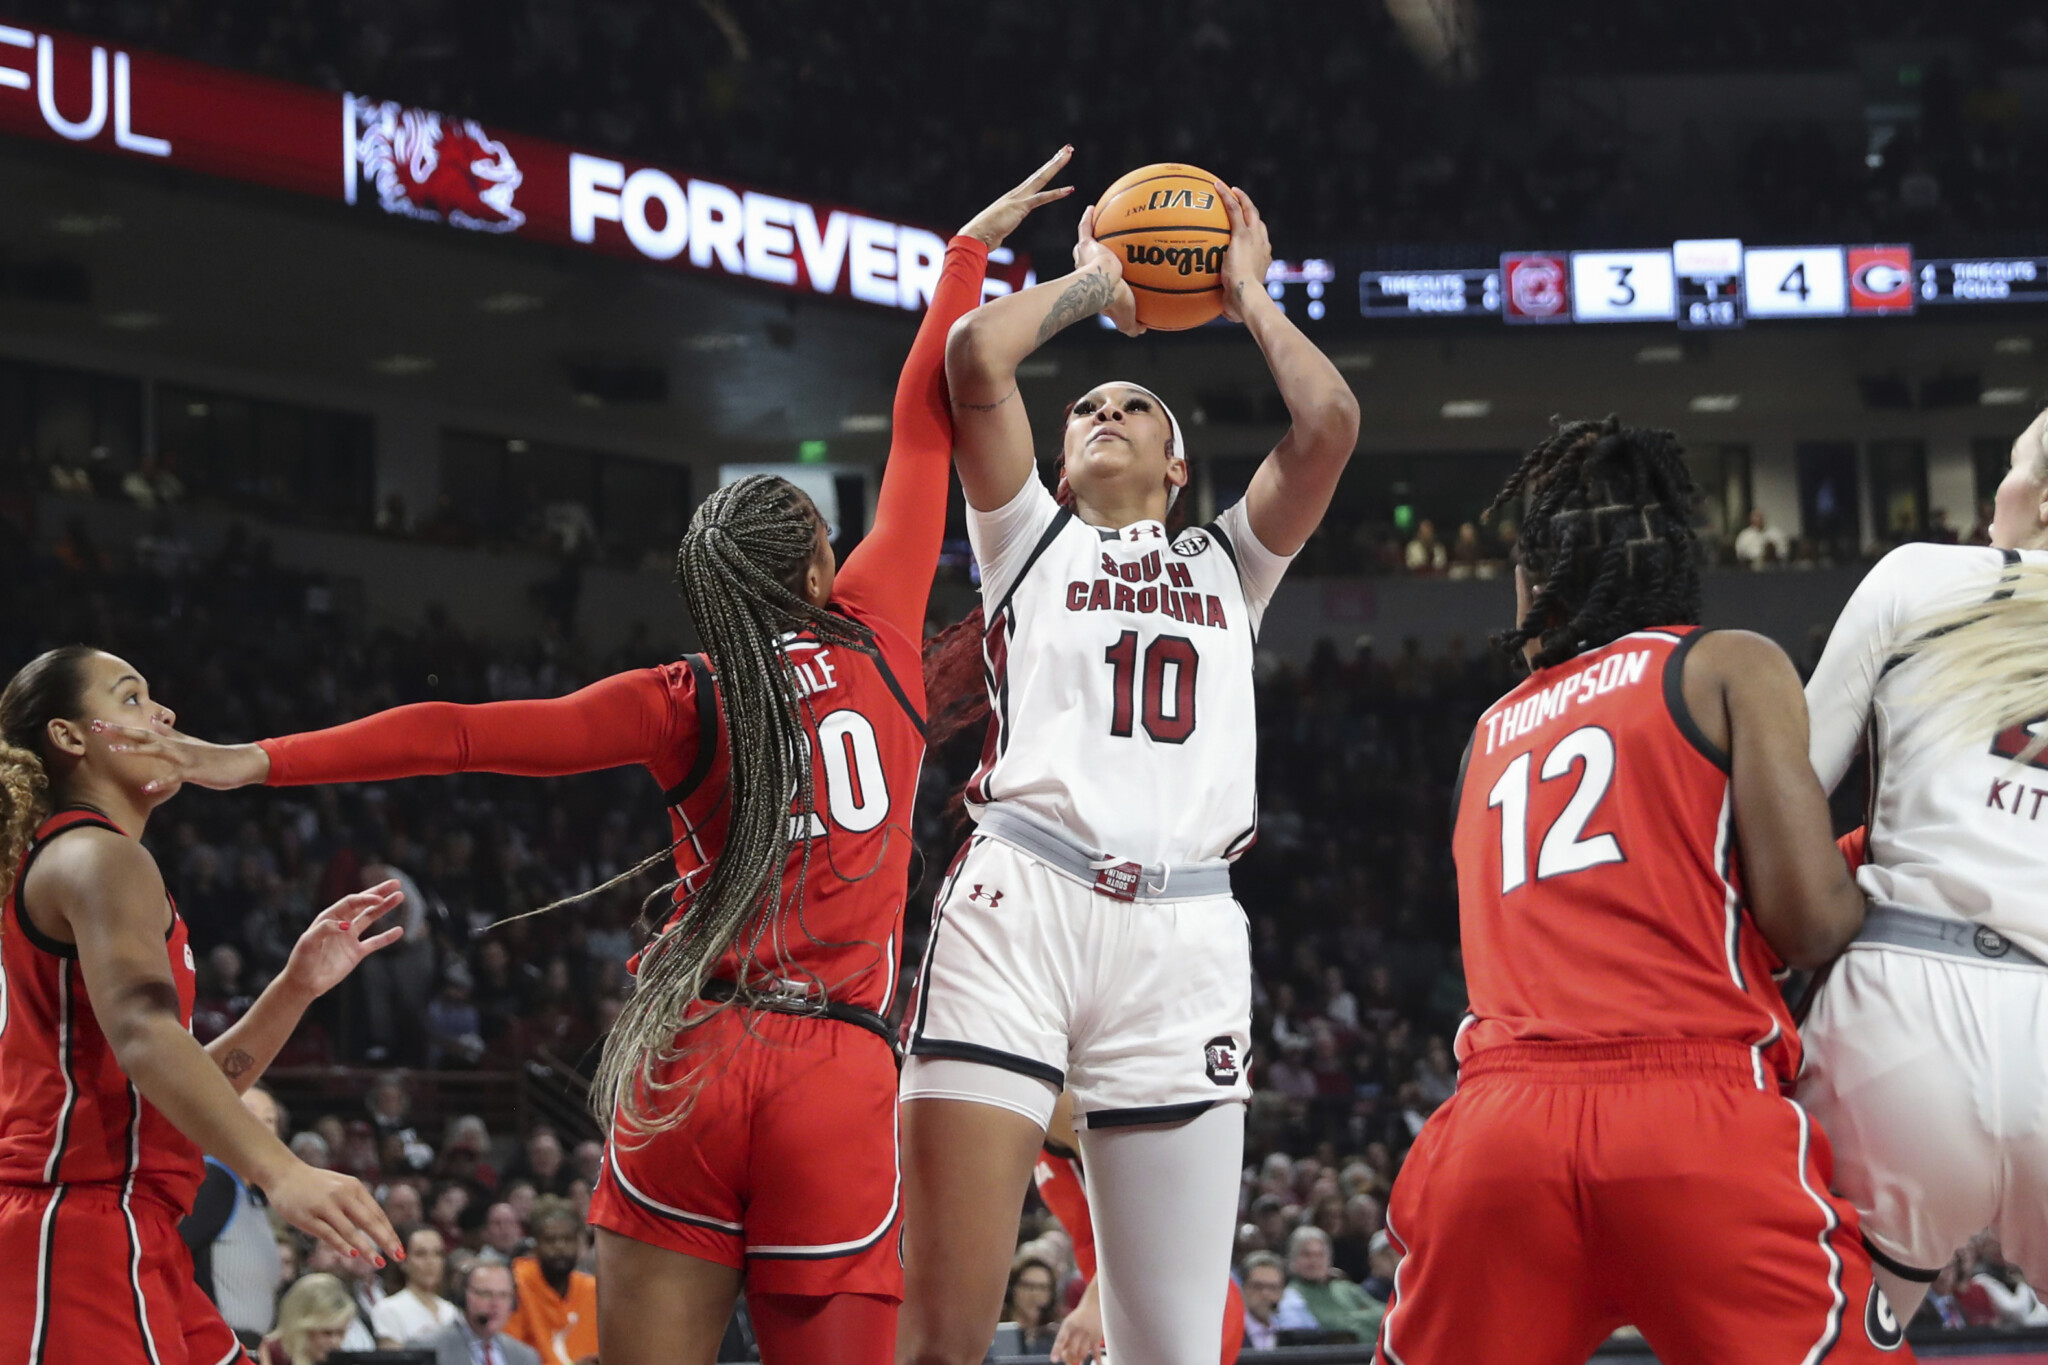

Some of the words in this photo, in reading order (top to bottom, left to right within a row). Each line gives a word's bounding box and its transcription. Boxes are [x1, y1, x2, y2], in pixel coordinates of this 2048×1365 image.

[1125, 205, 1146, 218] NXT
[1149, 190, 1214, 210] EVO
[570, 152, 950, 312] FOREVER
[1606, 265, 1636, 306] 3
[1777, 261, 1811, 302] 4
[1174, 536, 1205, 556] SEC
[1101, 549, 1194, 588] SOUH
[1066, 579, 1228, 630] CAROLINA
[1105, 629, 1199, 744] 10
[1485, 650, 1650, 755] THOMPSON
[1488, 724, 1627, 895] 12
[1106, 876, 1129, 891] SOUTH
